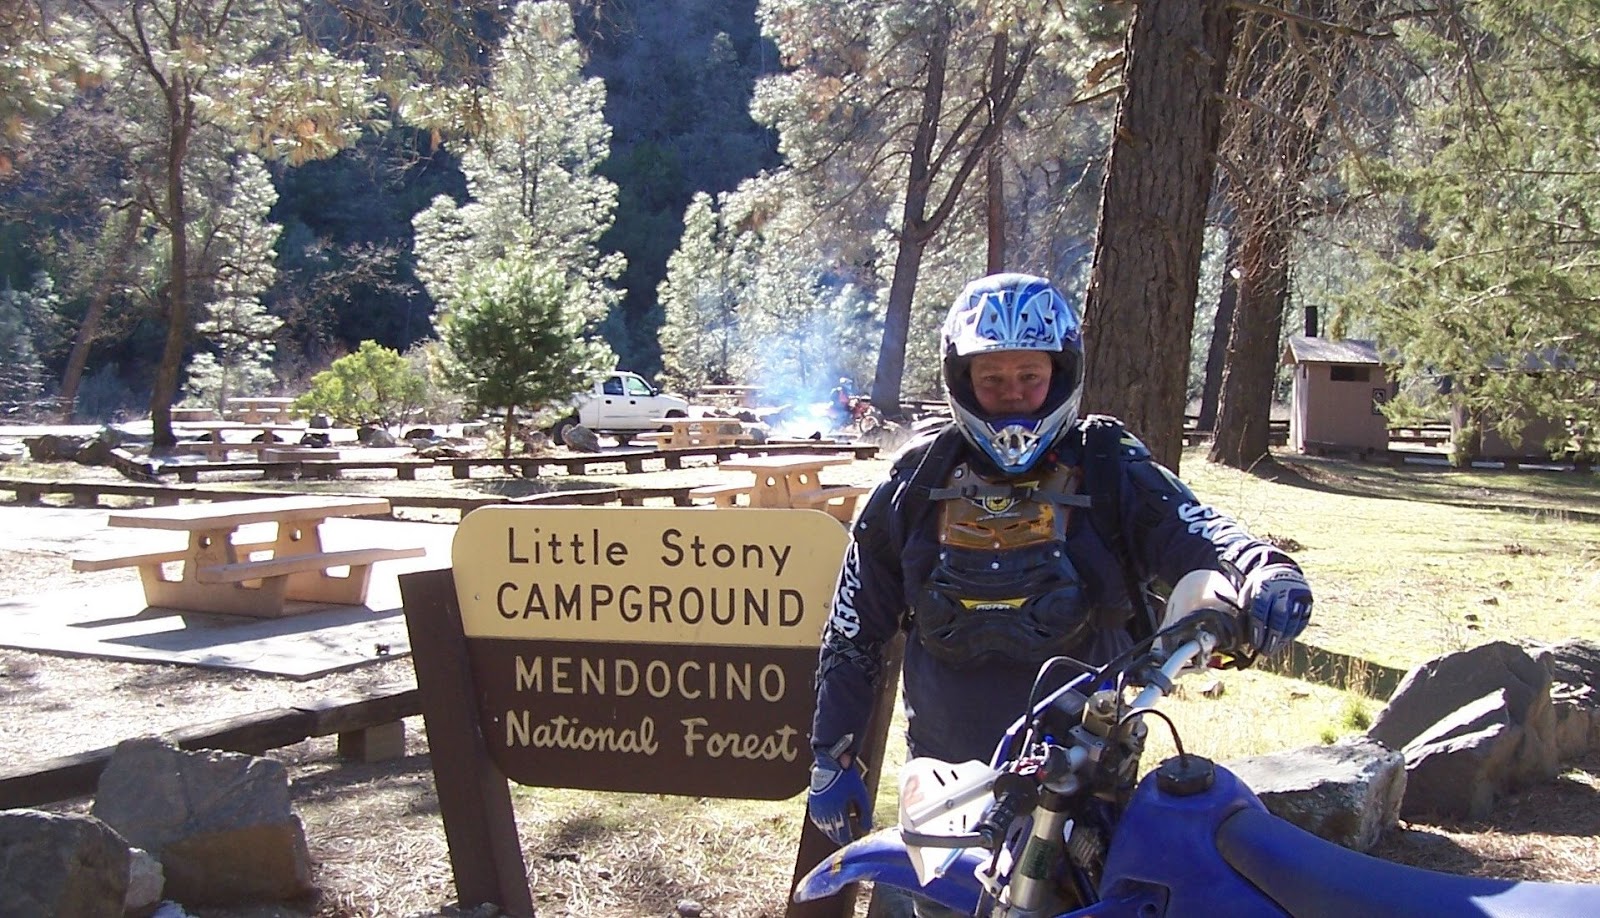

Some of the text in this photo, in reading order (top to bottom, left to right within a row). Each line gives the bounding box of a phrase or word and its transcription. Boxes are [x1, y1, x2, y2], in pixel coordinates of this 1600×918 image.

[508, 527, 792, 577] Little Stony
[497, 582, 805, 627] CAMPGROUND
[515, 655, 786, 702] MENDOCINO
[506, 710, 798, 763] National Forest
